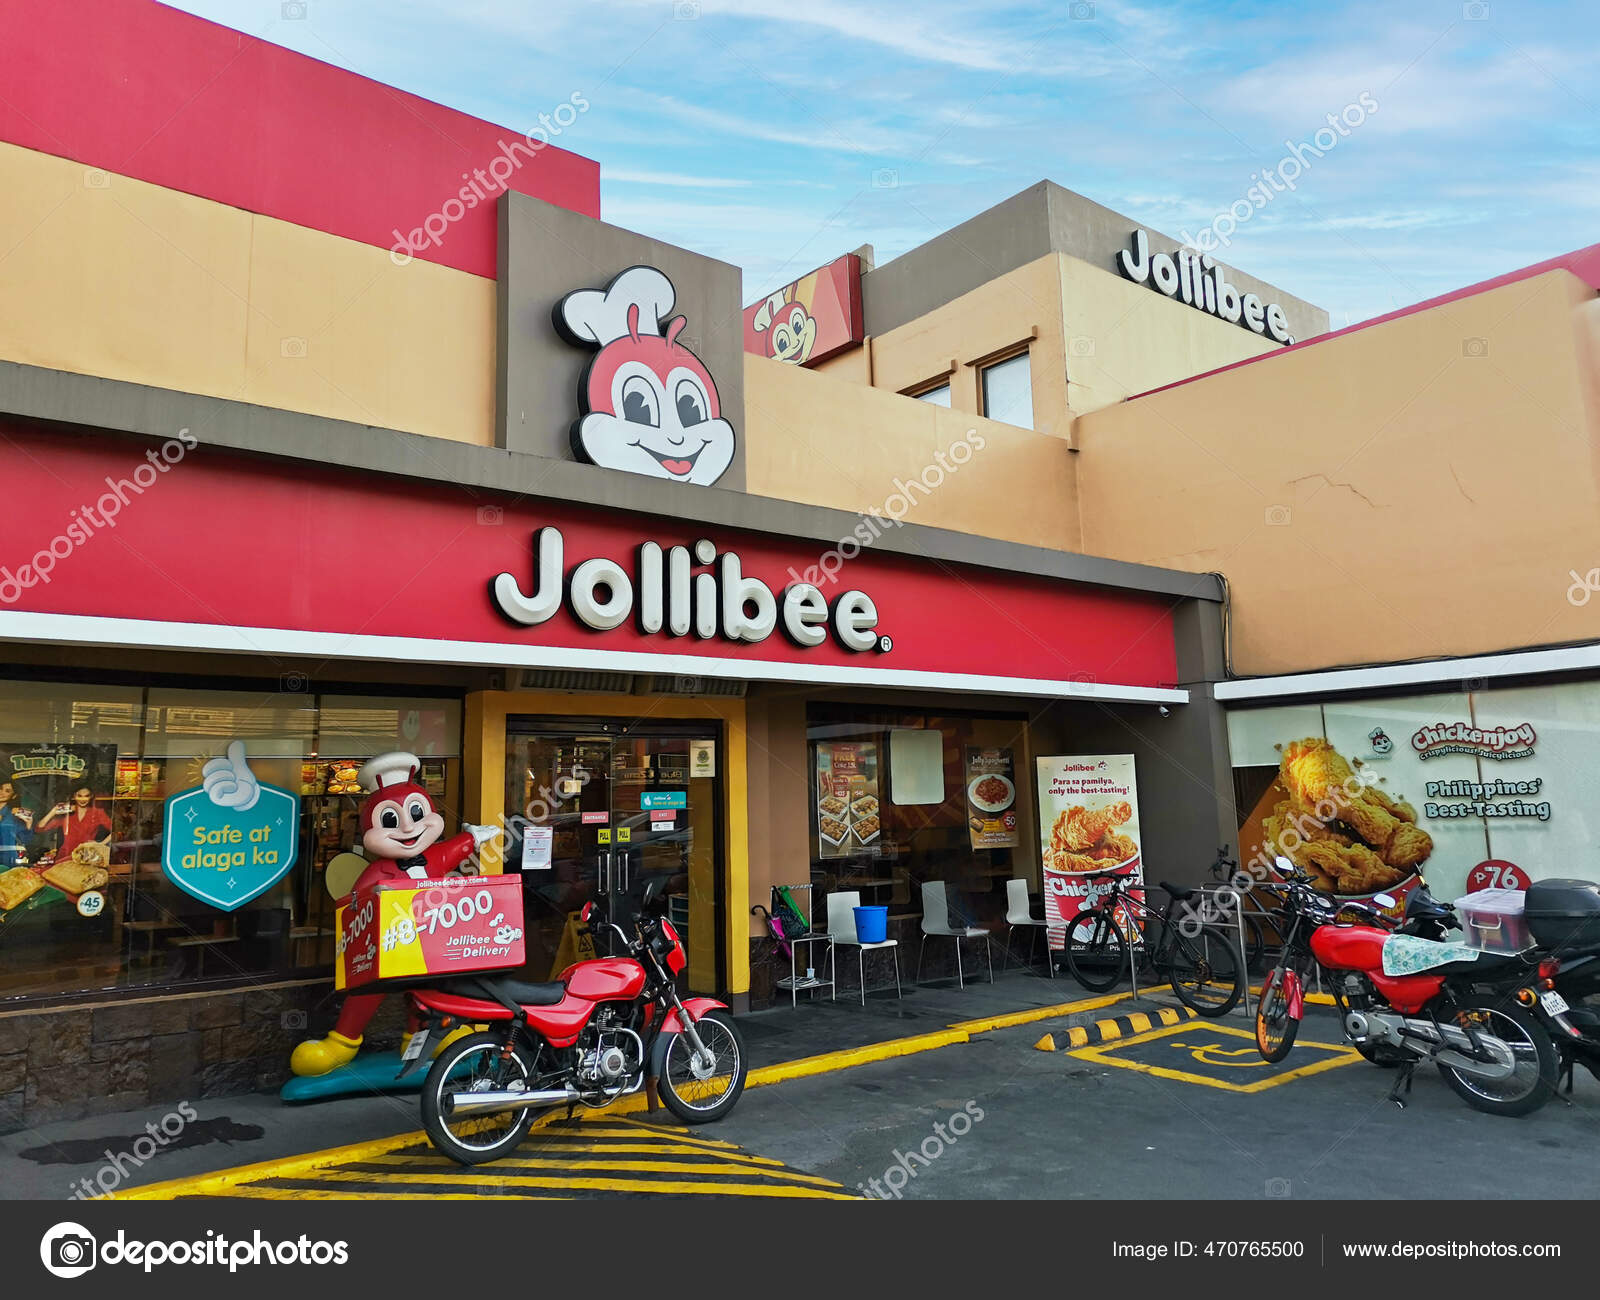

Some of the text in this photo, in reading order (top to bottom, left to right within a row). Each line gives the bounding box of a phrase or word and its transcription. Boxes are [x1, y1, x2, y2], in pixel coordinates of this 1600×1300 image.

[1117, 229, 1289, 343] Jollibee
[489, 526, 879, 652] Jollibee
[1411, 722, 1536, 752] Chickenjoy
[10, 754, 56, 771] Tuna
[1063, 763, 1095, 772] Jollibee
[1048, 786, 1130, 796] only the best-tasting!
[1082, 777, 1114, 786] pamilya,
[1425, 800, 1551, 821] Best-Tasting
[193, 825, 272, 845] Safe at
[182, 846, 278, 871] alaga ka
[382, 890, 493, 951] #8-7000
[446, 935, 490, 946] Jollibee
[463, 945, 510, 959] Delivery
